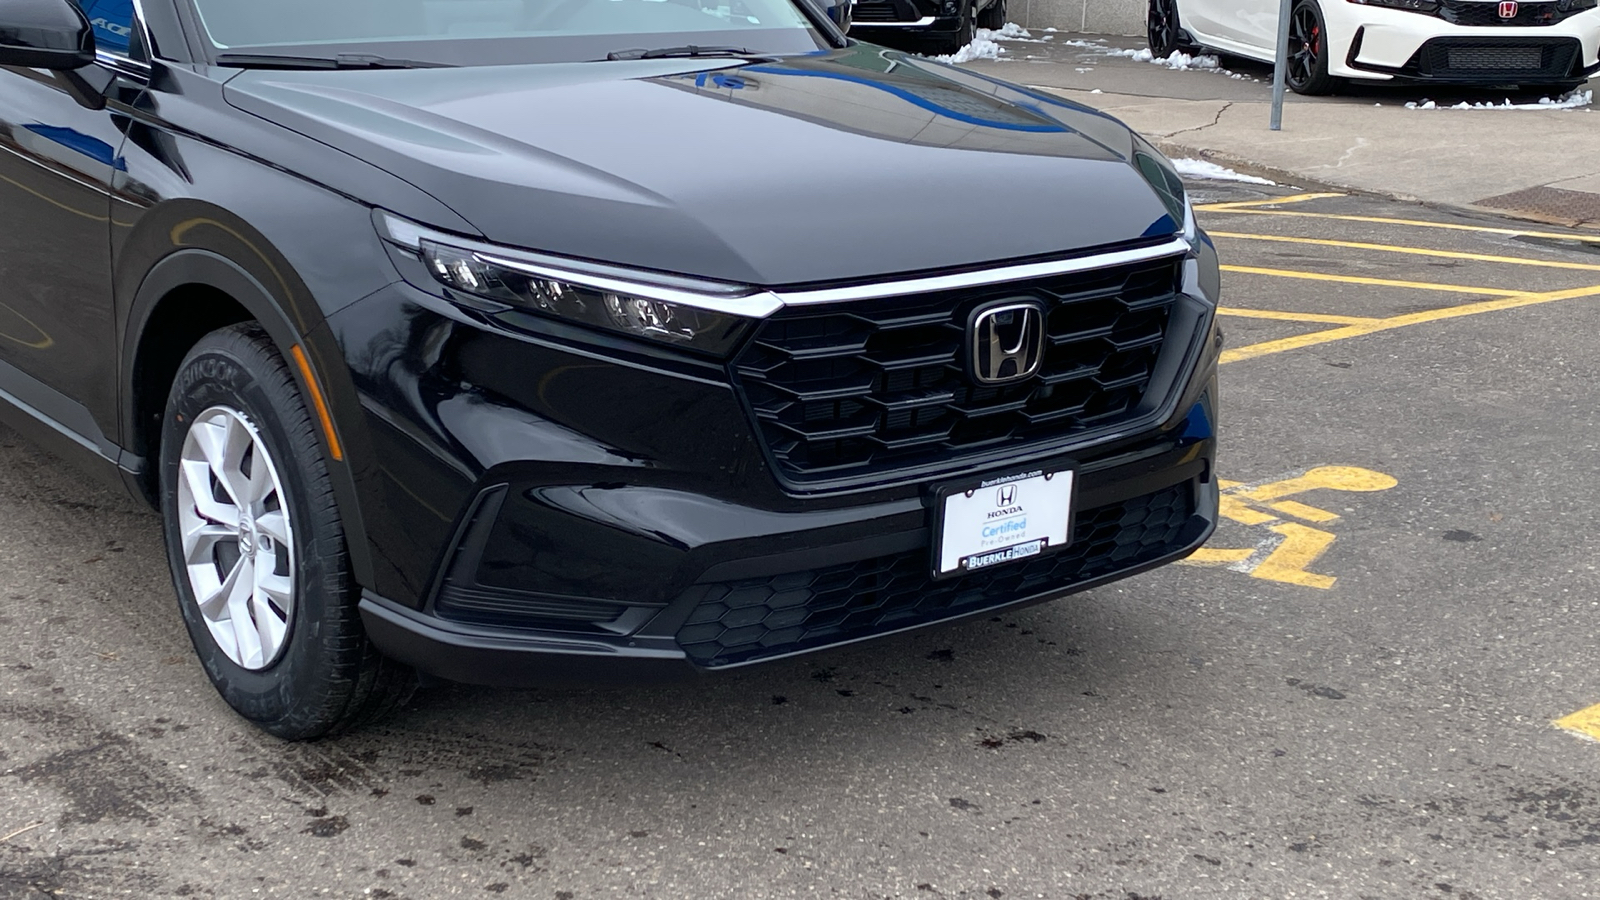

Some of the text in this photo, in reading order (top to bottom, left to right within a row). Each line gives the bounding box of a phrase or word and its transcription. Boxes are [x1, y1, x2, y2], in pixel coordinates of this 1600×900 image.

[980, 470, 1043, 488] buerklehonda.com
[987, 505, 1023, 519] HONDA
[982, 518, 1027, 538] Certified
[980, 531, 1026, 547] Pre-Owned
[969, 544, 1039, 568] BUERKLE HONDA
